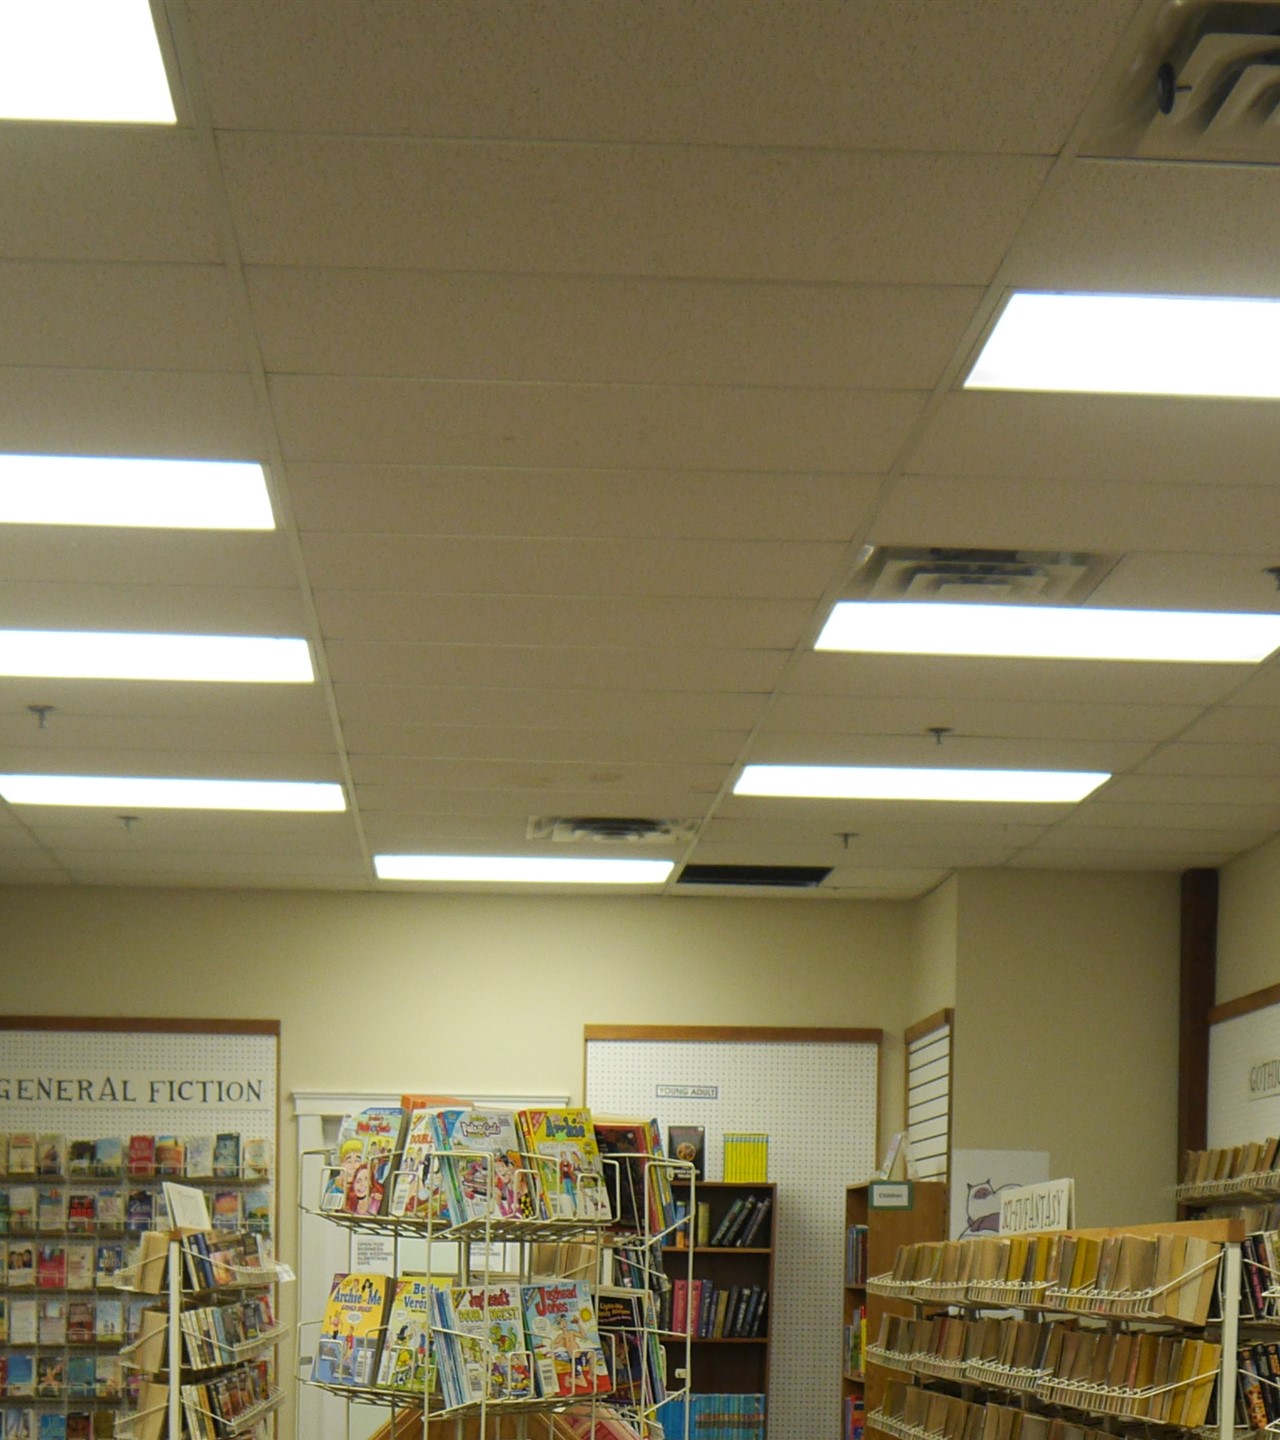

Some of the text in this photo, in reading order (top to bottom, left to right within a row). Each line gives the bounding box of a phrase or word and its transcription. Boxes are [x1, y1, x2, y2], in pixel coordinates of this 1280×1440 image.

[149, 1078, 263, 1103] FICTION
[659, 1087, 716, 1097] YOUNG ADULT
